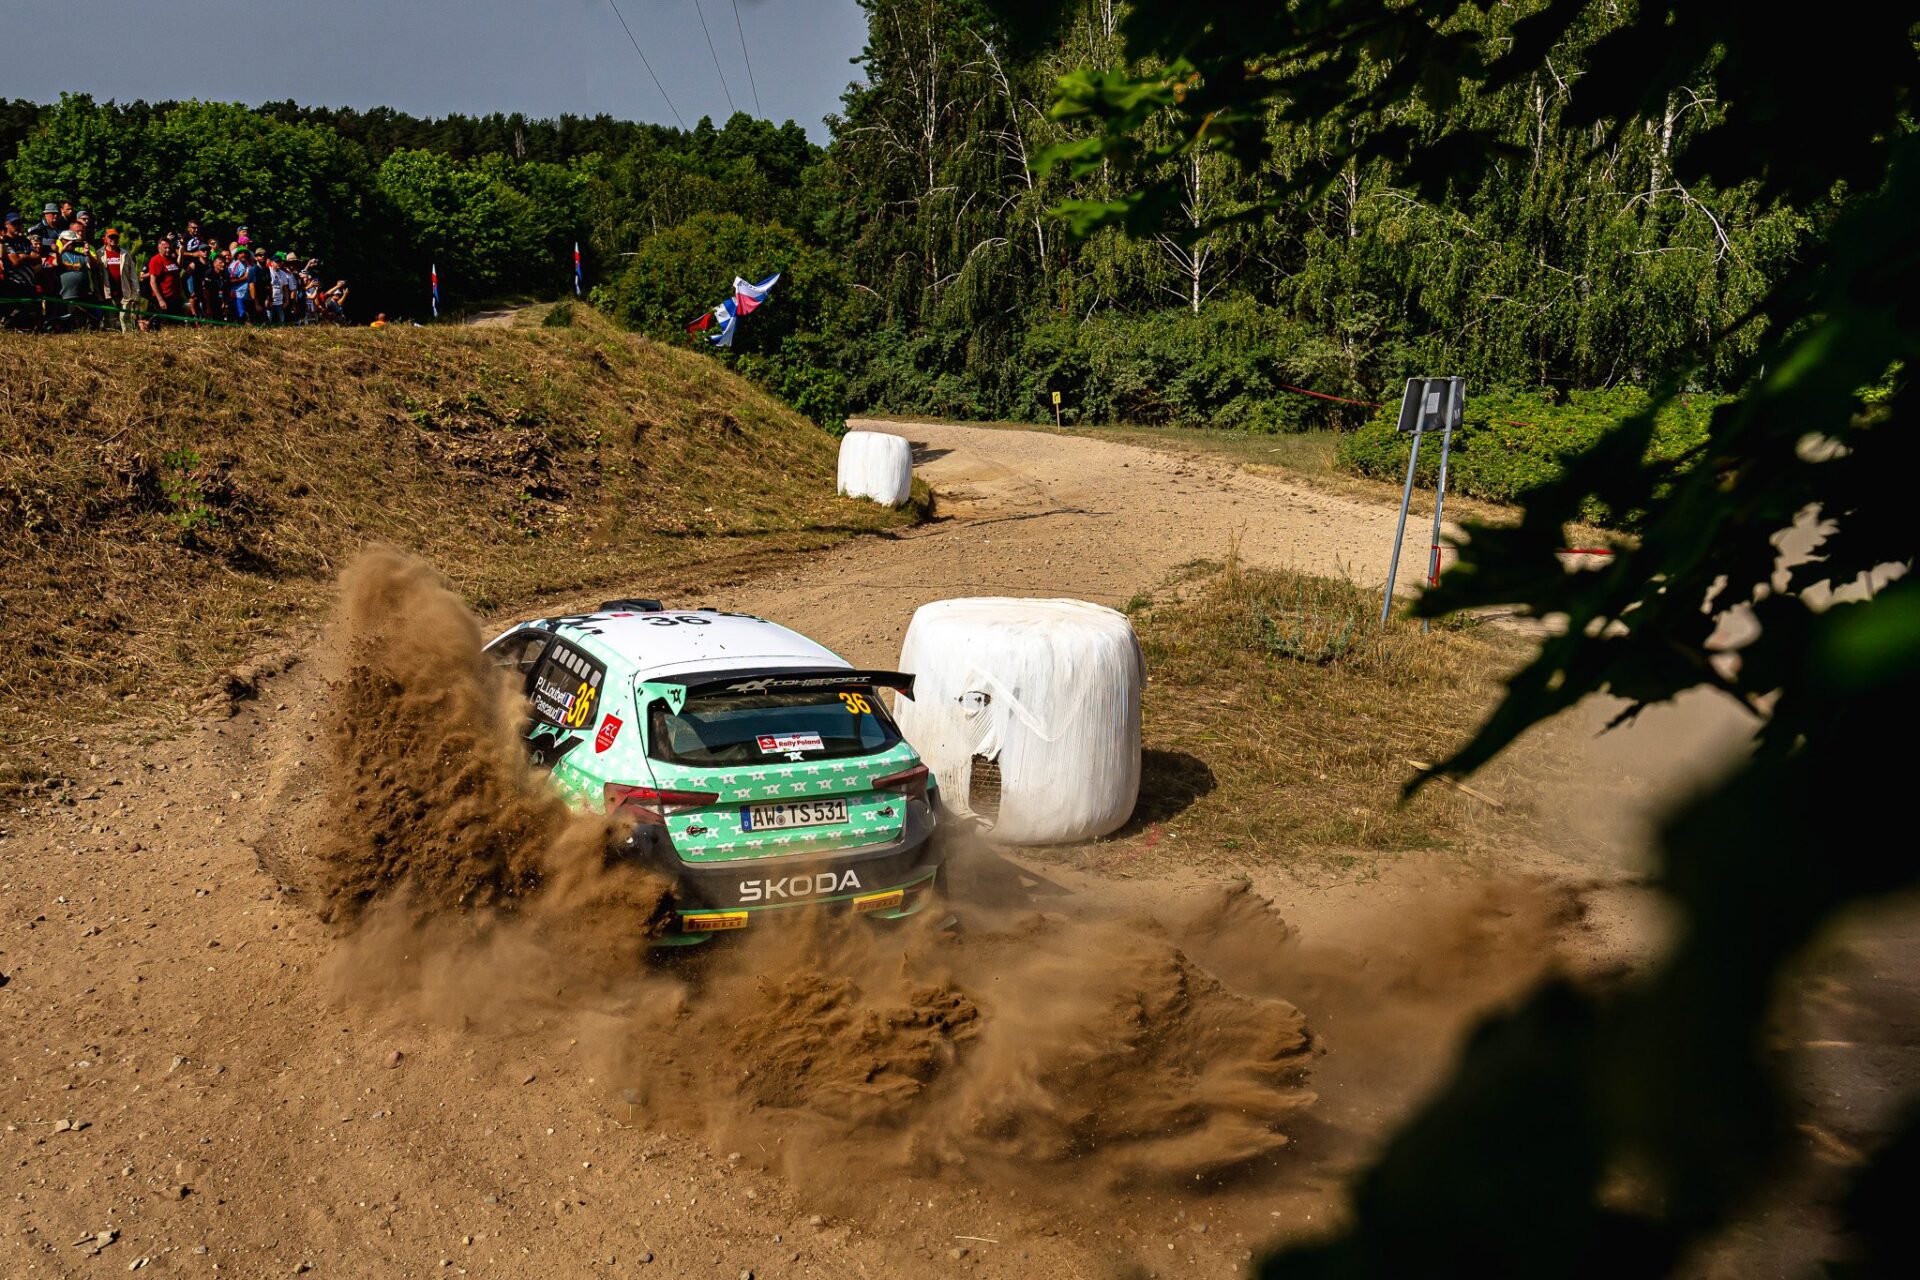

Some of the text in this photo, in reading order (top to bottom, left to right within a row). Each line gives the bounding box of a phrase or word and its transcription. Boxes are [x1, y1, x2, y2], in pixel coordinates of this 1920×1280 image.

[641, 616, 712, 626] 36
[567, 682, 596, 728] 36
[839, 692, 871, 714] 36
[778, 740, 796, 748] Rally
[796, 738, 821, 746] Poland
[753, 801, 846, 827] AW TS 531
[739, 869, 861, 902] SKODA
